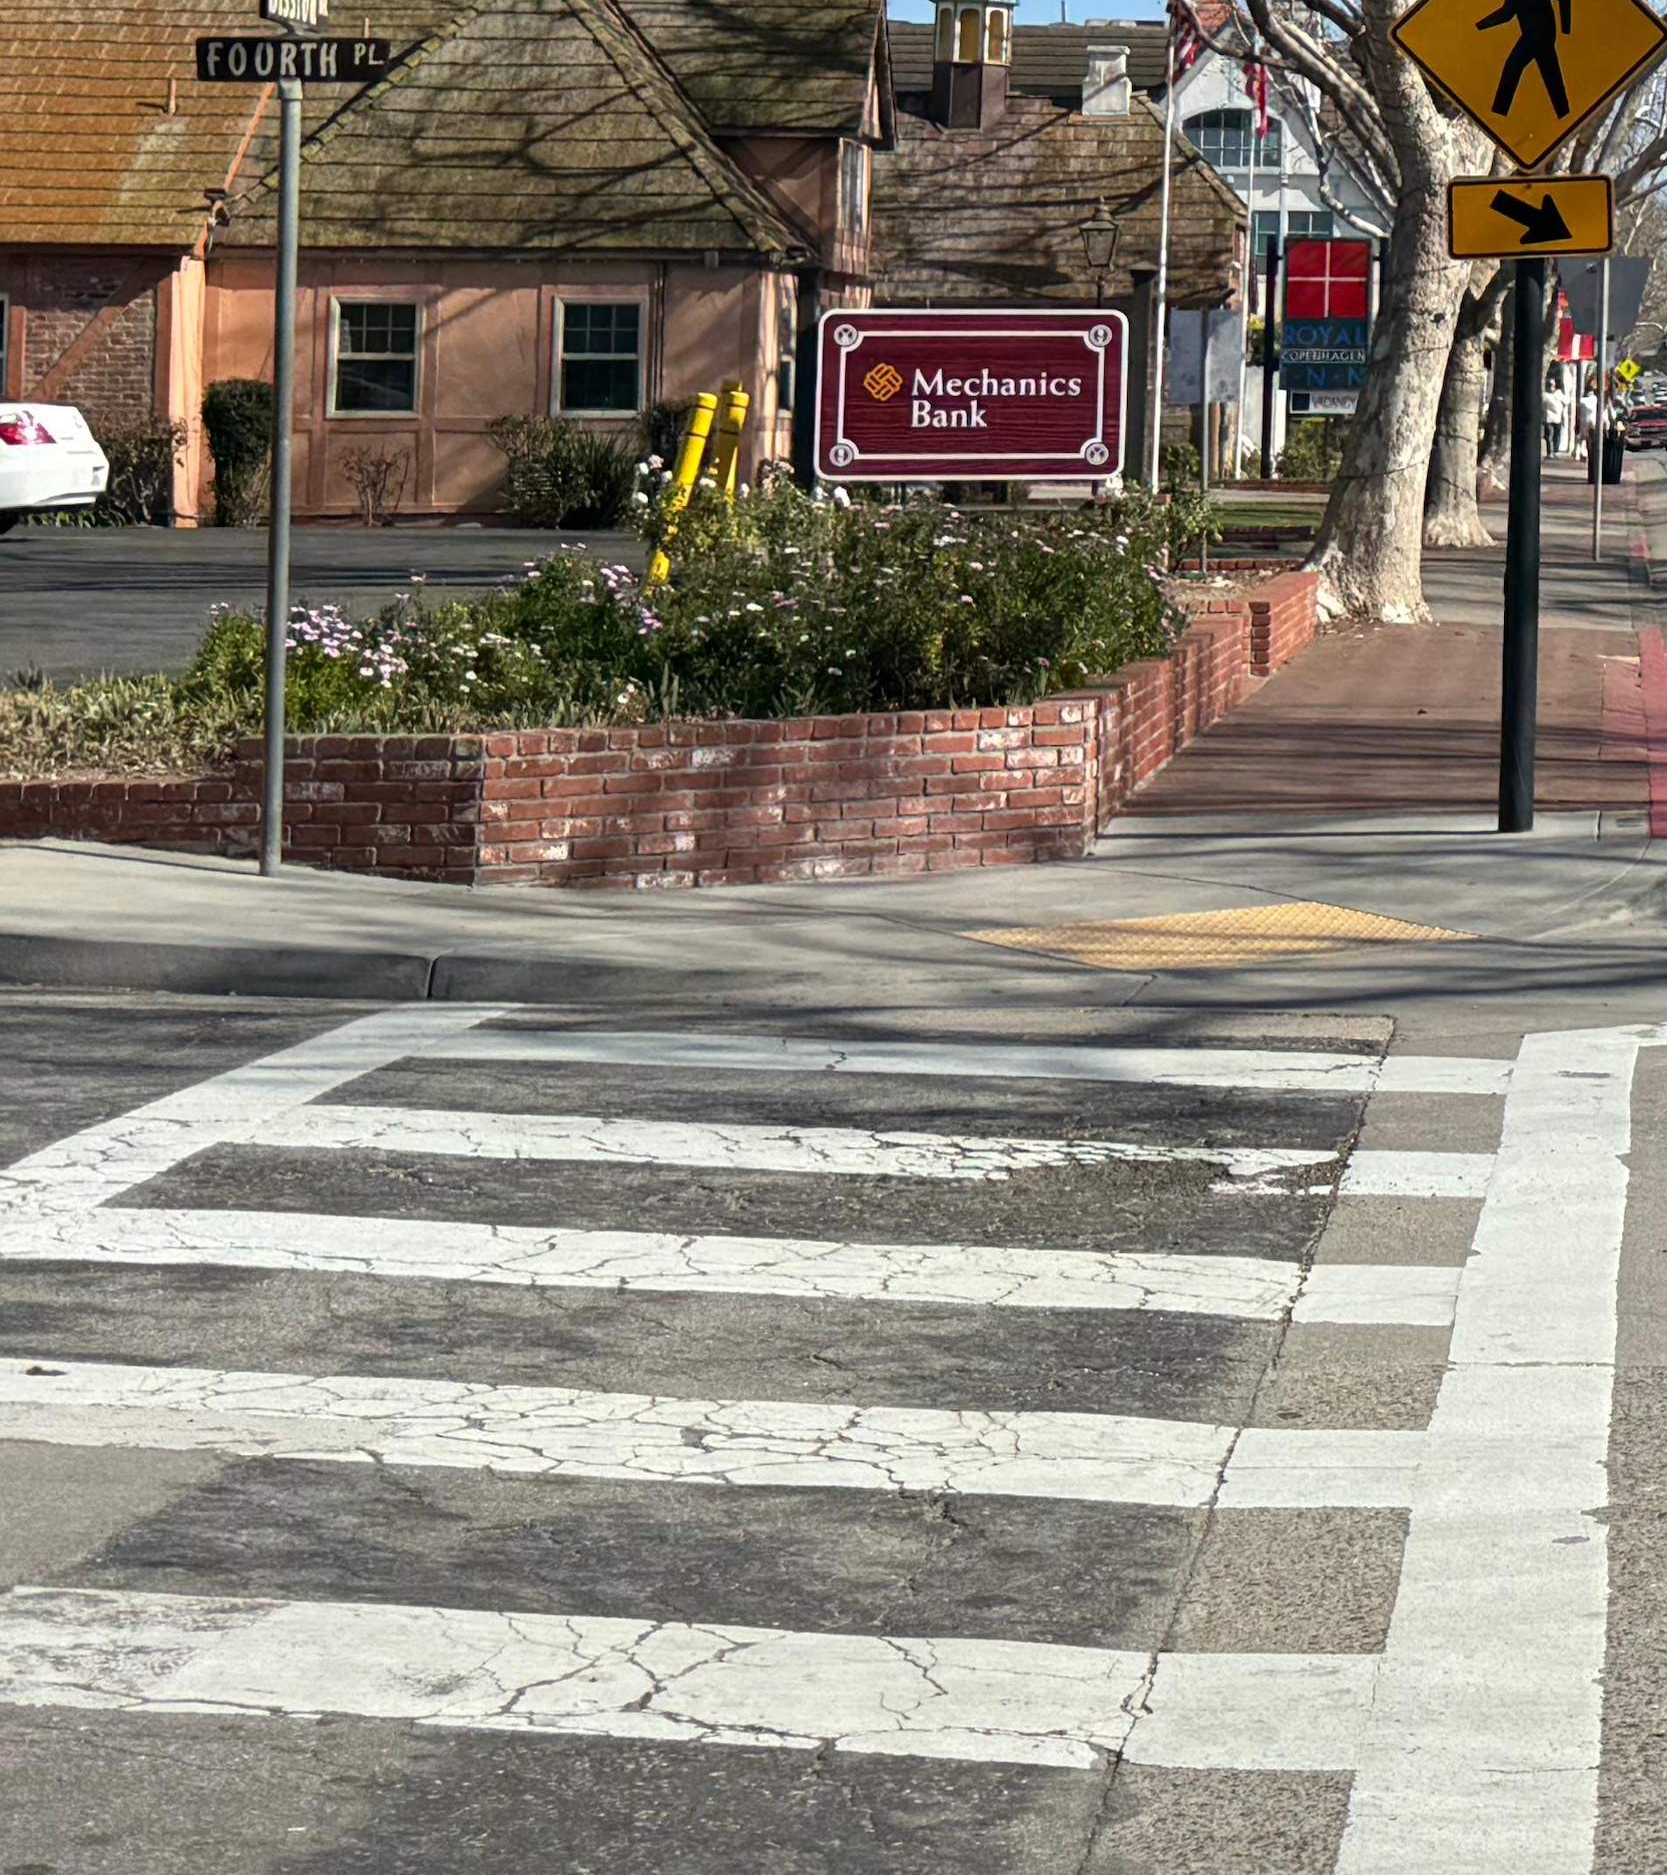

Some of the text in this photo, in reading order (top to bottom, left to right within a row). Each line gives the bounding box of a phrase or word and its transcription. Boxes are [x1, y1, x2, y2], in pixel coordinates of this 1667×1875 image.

[207, 41, 338, 77] FOURTH
[1283, 324, 1366, 346] ROYAL
[1281, 350, 1367, 361] COPENHAGEN
[911, 368, 1082, 397] Mechanics
[911, 400, 988, 428] Bank
